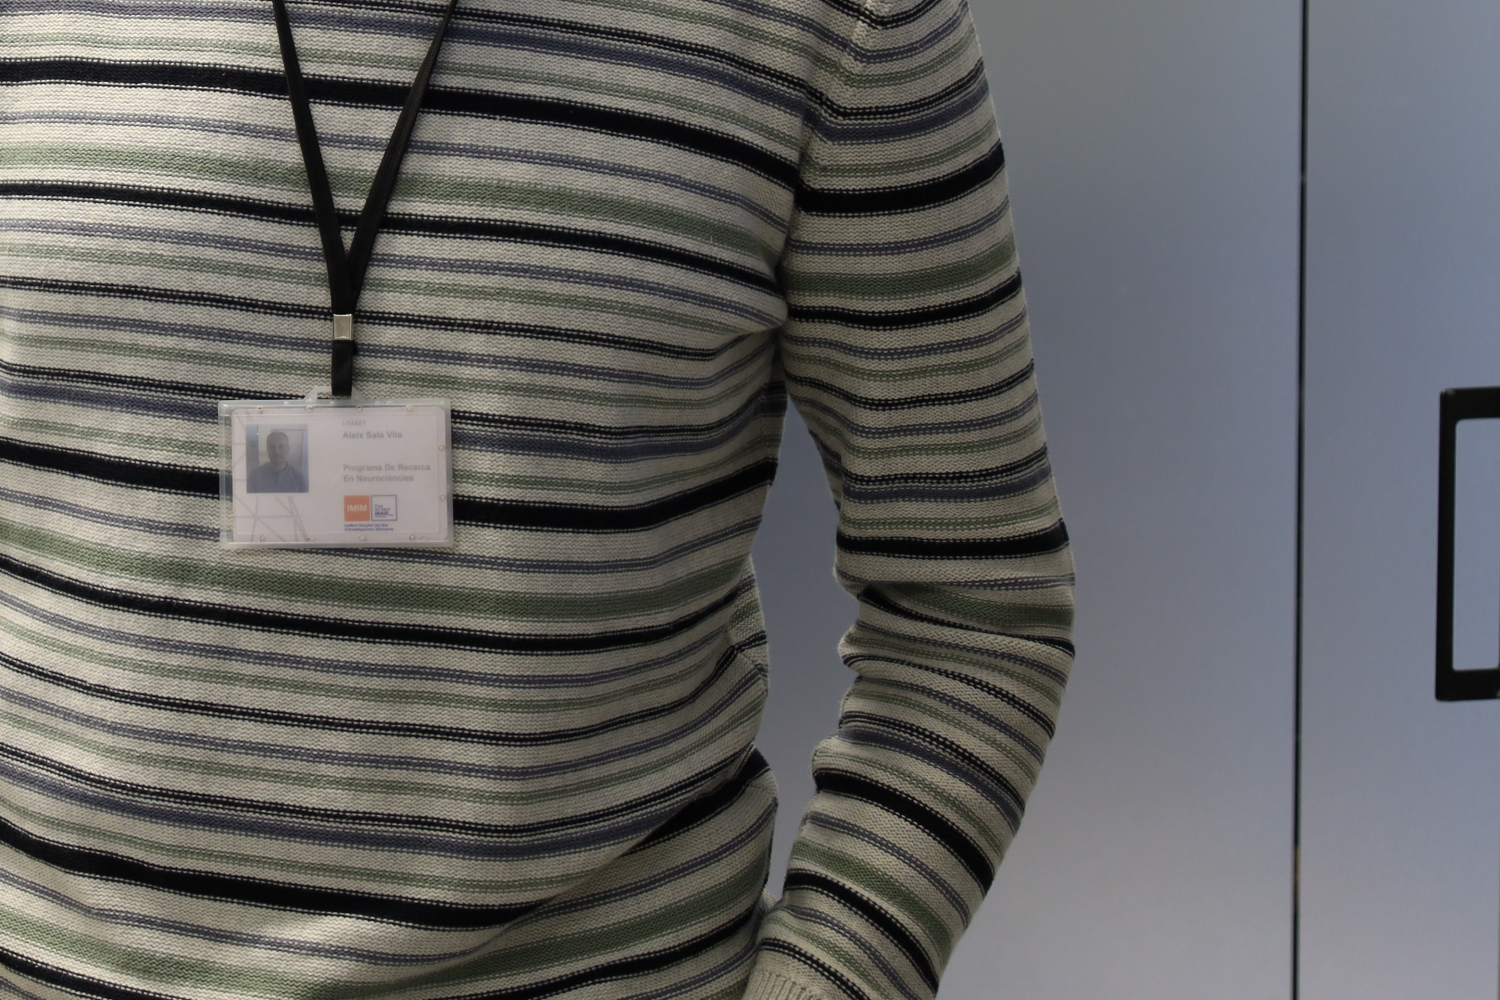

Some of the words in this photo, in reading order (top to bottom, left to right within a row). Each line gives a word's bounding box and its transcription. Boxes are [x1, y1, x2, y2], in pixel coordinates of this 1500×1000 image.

[342, 431, 364, 439] Aleix
[365, 431, 384, 439] Sala
[386, 430, 403, 439] Vila
[343, 463, 383, 473] Programa
[384, 463, 395, 471] De
[397, 463, 431, 471] Recerca
[343, 474, 354, 482] En
[346, 504, 368, 512] IMIM
